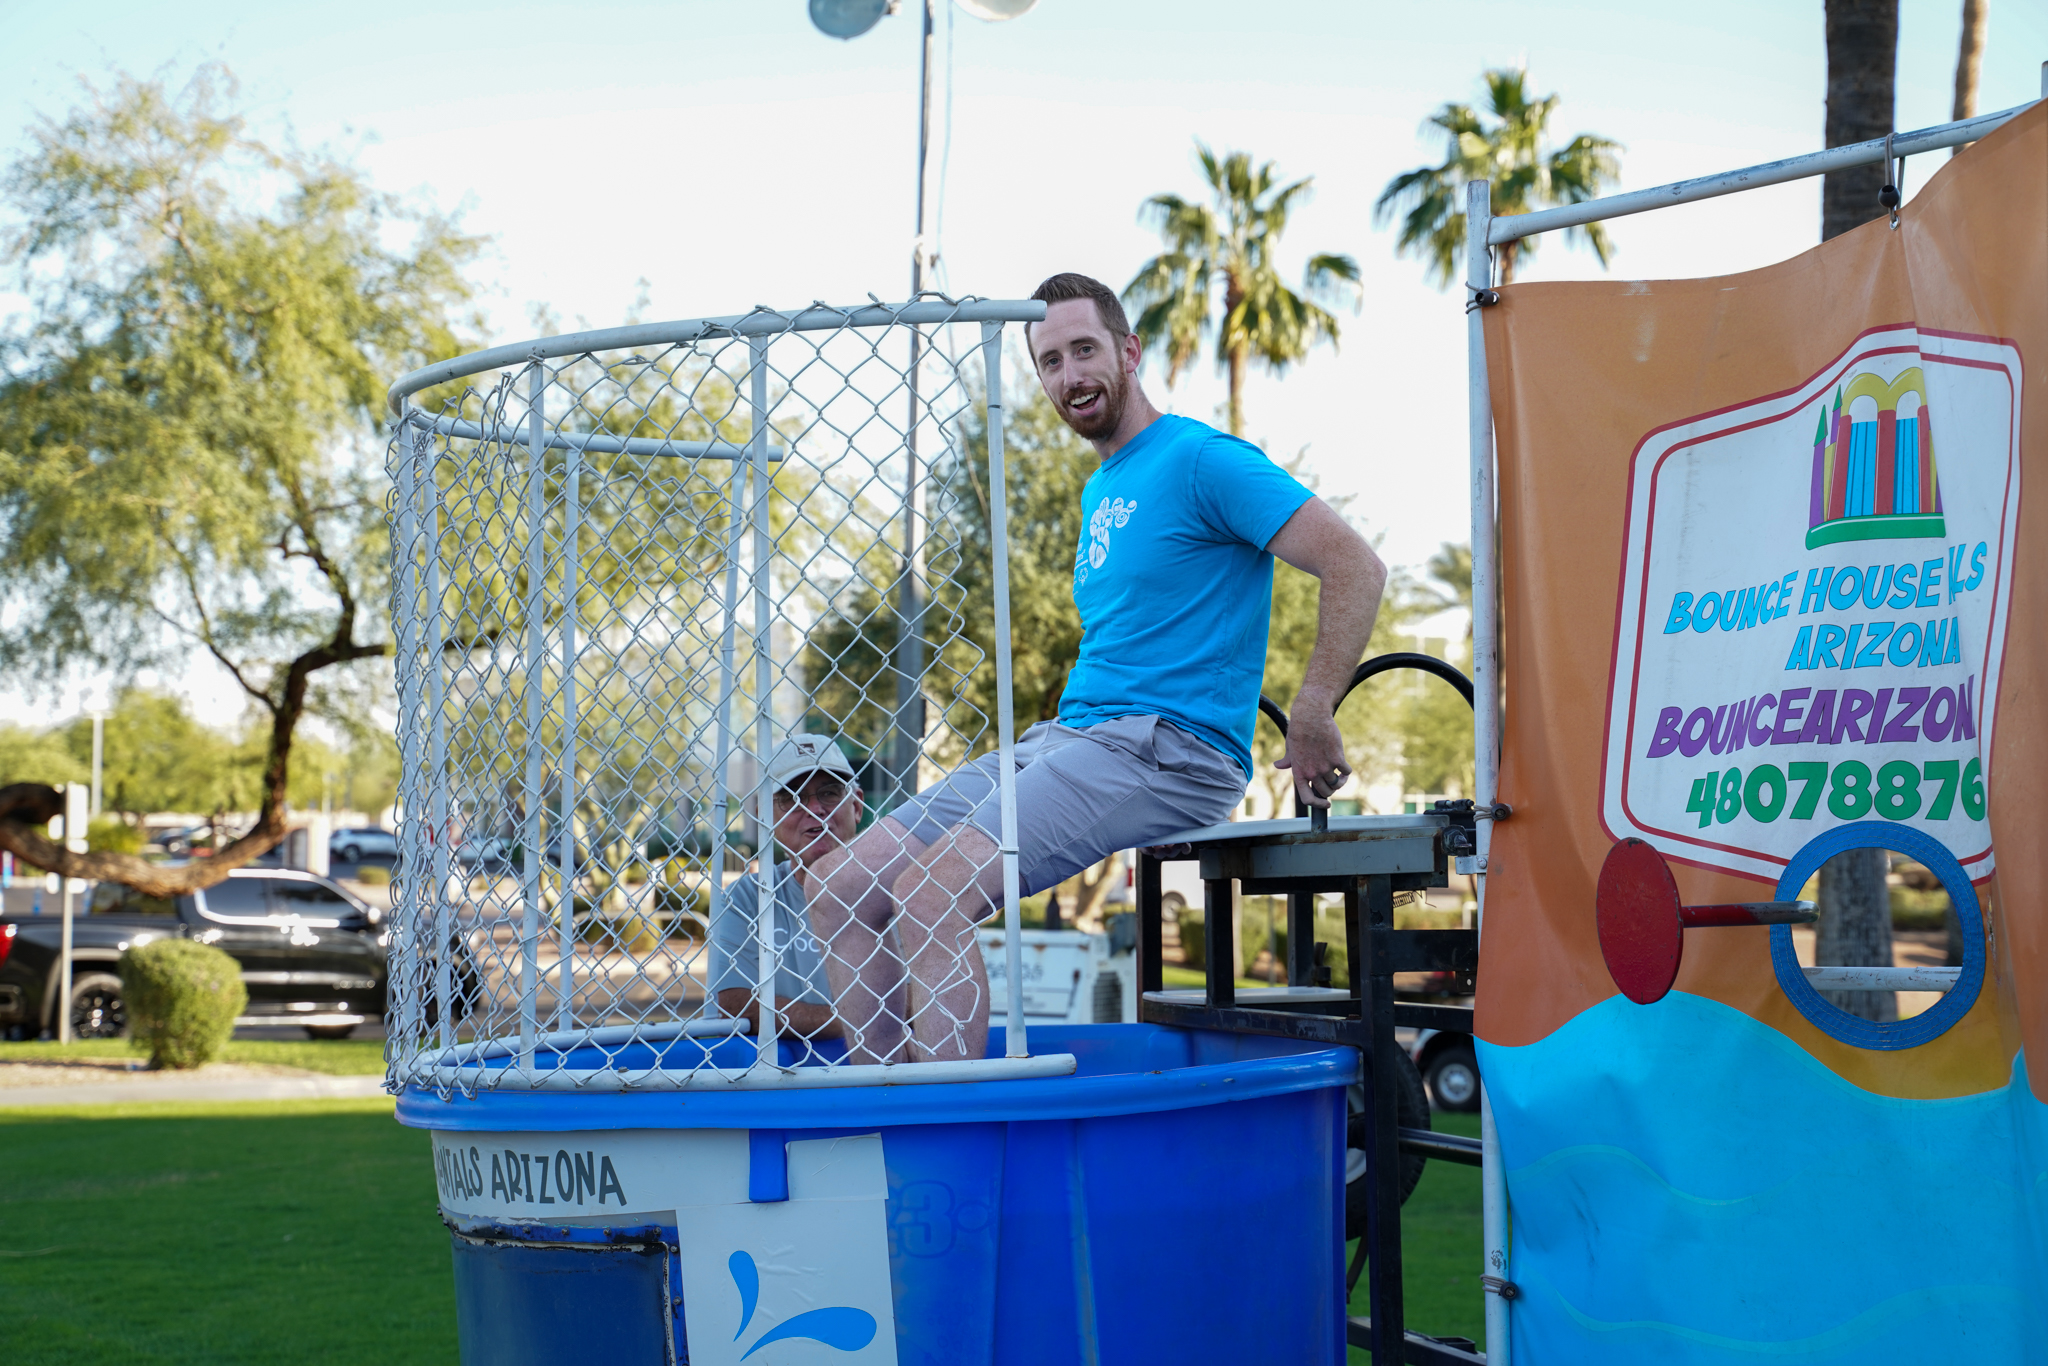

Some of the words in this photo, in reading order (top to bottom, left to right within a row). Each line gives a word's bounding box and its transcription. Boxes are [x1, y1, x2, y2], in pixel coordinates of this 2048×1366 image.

[1663, 570, 1799, 634] BOUNCE
[1799, 557, 1944, 615] HOUSE
[1784, 616, 1961, 671] ARIZONA
[1686, 757, 1986, 829] 48078876
[491, 1149, 627, 1206] ARIZONA
